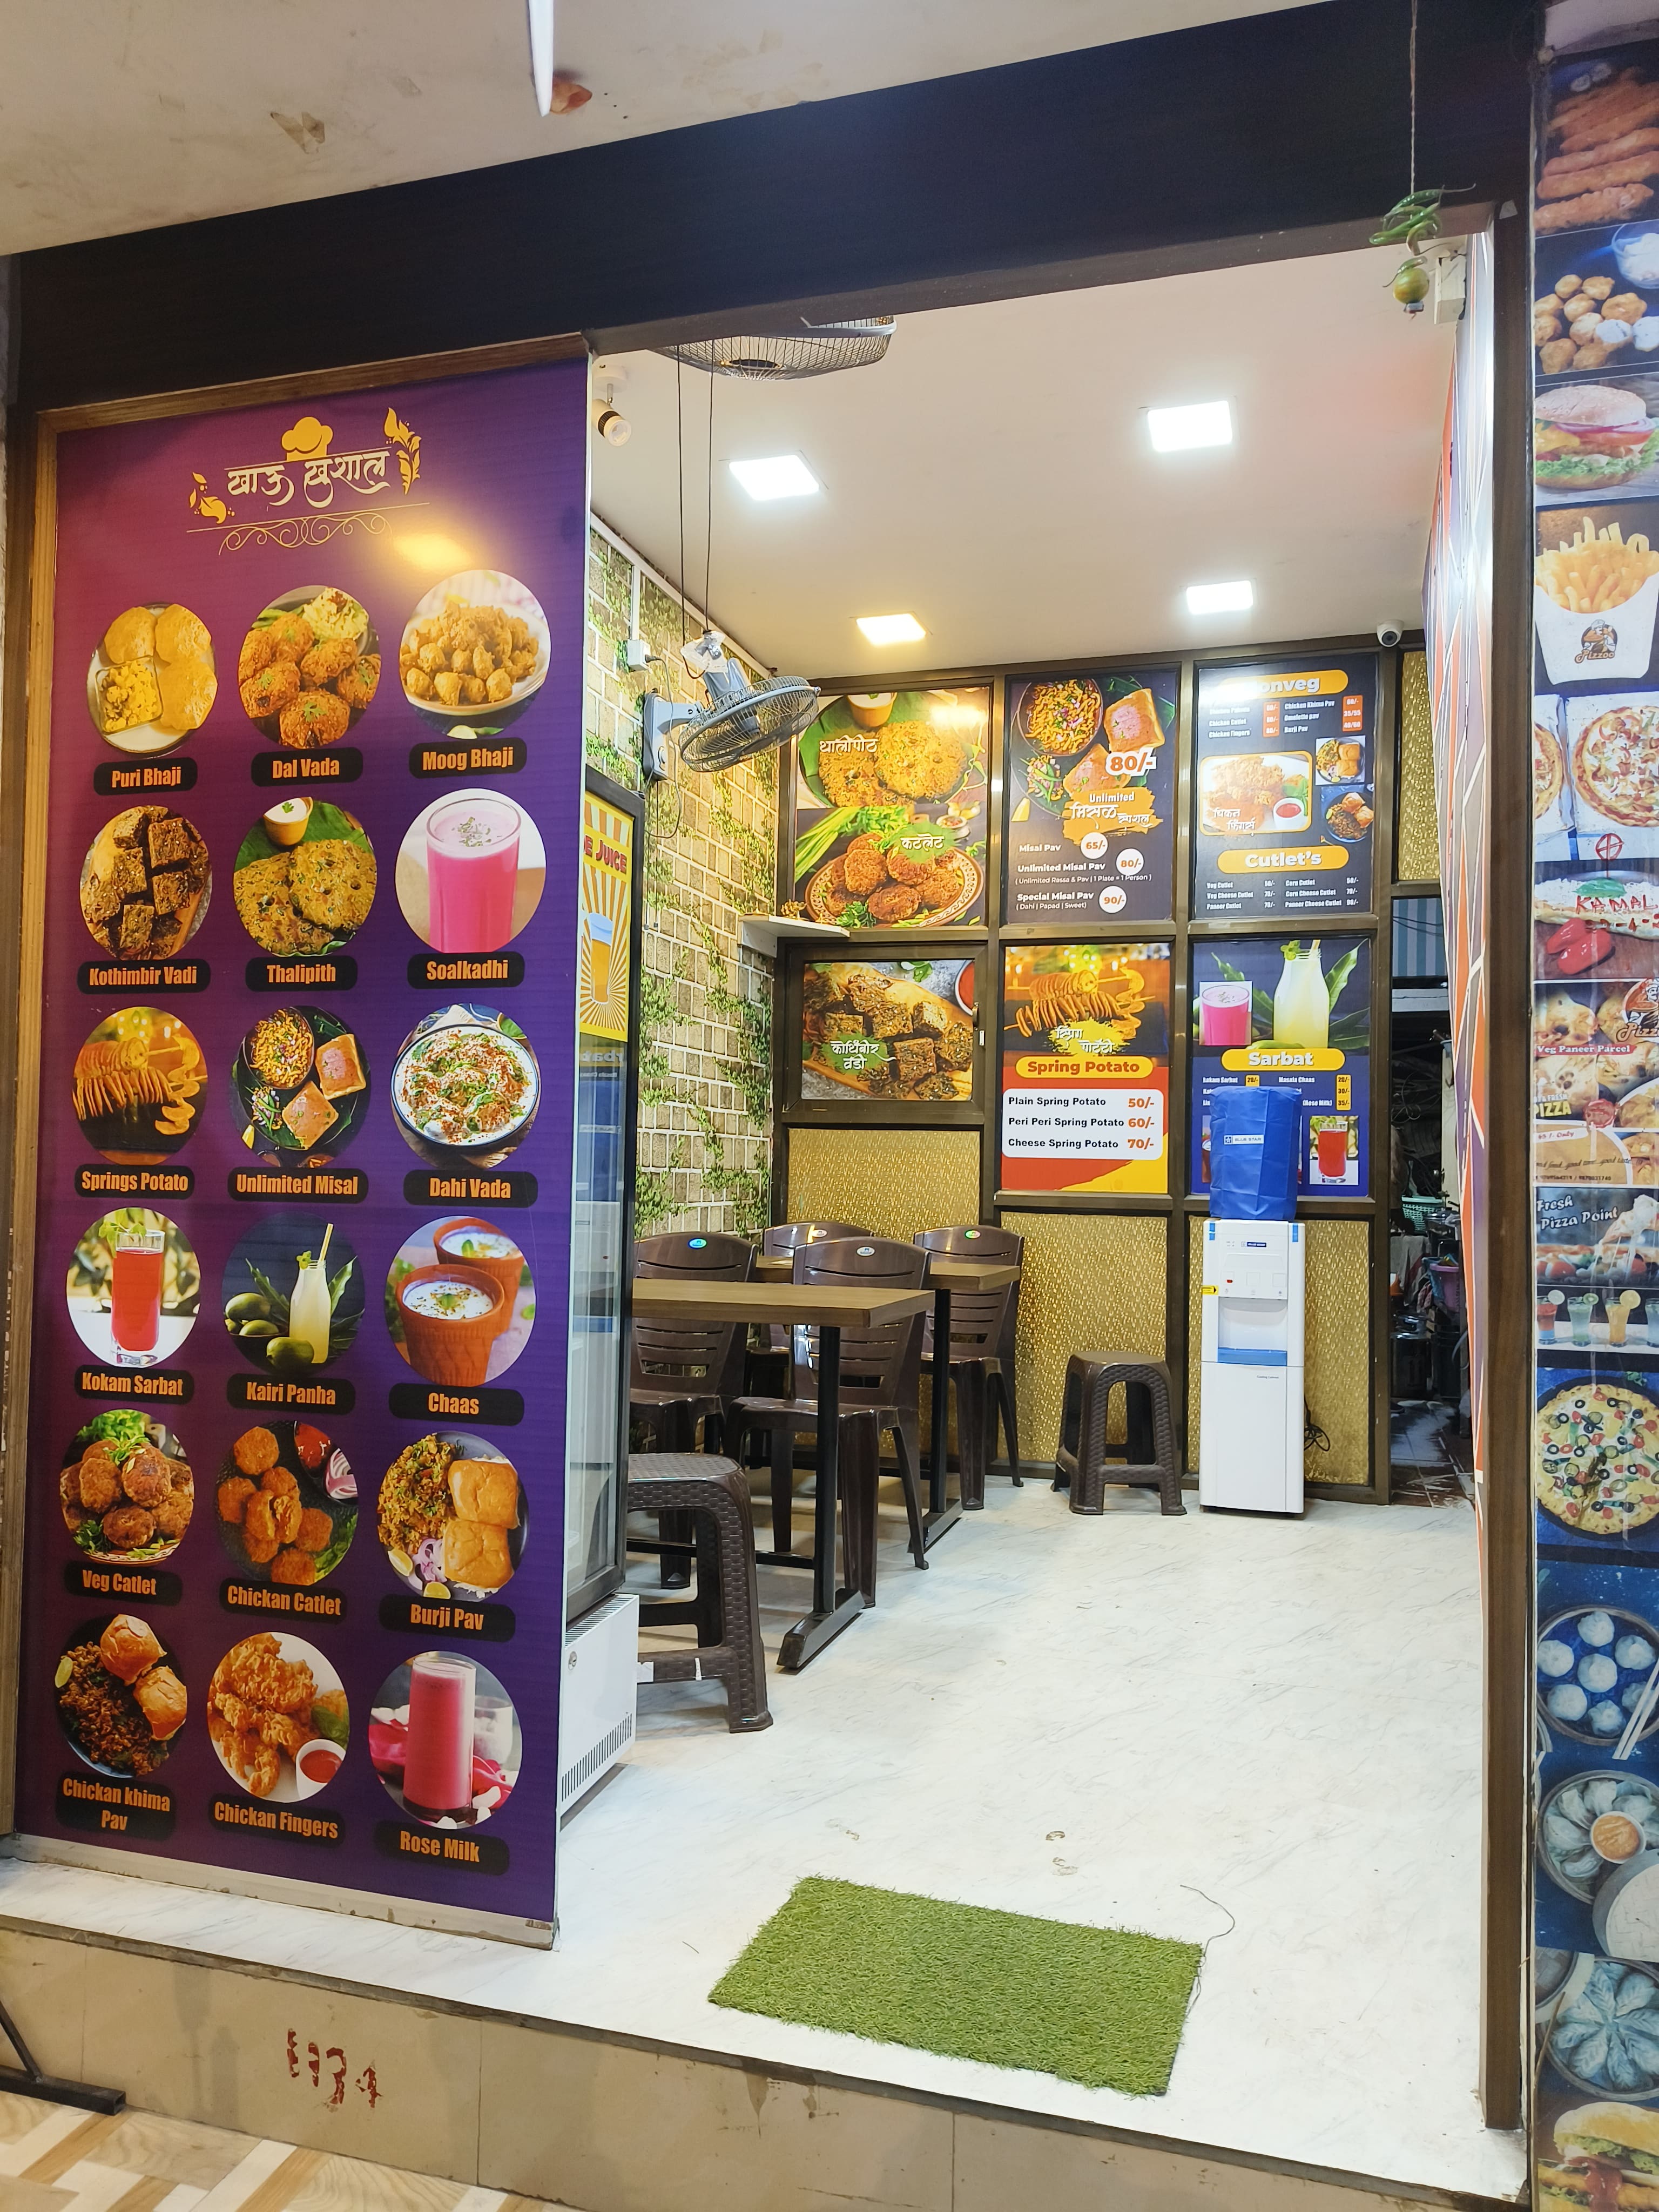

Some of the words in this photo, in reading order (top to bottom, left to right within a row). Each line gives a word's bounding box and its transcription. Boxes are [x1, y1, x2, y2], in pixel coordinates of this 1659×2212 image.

[227, 465, 294, 506] खाऊ
[304, 451, 391, 508] खुशाल
[1575, 649, 1615, 663] Pizzoo
[1256, 678, 1320, 693] onveg
[819, 734, 879, 756] थालीपीठ
[272, 759, 298, 779] Dal
[301, 758, 340, 777] Vada
[422, 750, 467, 772] Moog
[470, 747, 514, 768] Bhaji
[1110, 752, 1152, 772] 80/-
[112, 768, 141, 788] Puri
[143, 767, 181, 787] Bhaji
[1089, 792, 1134, 802] Unlimited
[1069, 801, 1119, 830] मिसळ
[900, 833, 944, 851] कटलेट
[1020, 844, 1042, 852] Misal
[1086, 840, 1105, 850] 65/-
[596, 838, 627, 875] JUICE
[1017, 864, 1061, 872] Unlimited
[1063, 863, 1087, 871] Misal
[1121, 859, 1142, 868] 80/-
[1017, 893, 1049, 902] Special
[1051, 892, 1075, 900] Misal
[1104, 895, 1125, 905] 90/-
[89, 967, 160, 987] Kothimbir
[161, 966, 197, 984] Vadi
[267, 964, 336, 984] Thalipith
[426, 960, 508, 981] Soalkadhi
[1616, 1022, 1659, 1042] Pizz
[1249, 1051, 1313, 1066] Sarbat
[1536, 1046, 1556, 1055] Veg
[843, 1054, 868, 1070] वडी
[1028, 1060, 1080, 1075] Spring
[1085, 1062, 1139, 1073] Potato
[1037, 1097, 1069, 1107] Spring
[1128, 1097, 1154, 1109] 50/-
[1533, 1101, 1572, 1117] PIZZA
[1055, 1118, 1087, 1127] Spring
[1128, 1117, 1155, 1129] 60/-
[1049, 1139, 1081, 1149] Spring
[1128, 1137, 1154, 1150] 70/-
[82, 1171, 138, 1191] Springs
[140, 1171, 188, 1191] Potato
[237, 1174, 312, 1195] Unlimited
[314, 1175, 358, 1195] Misal
[429, 1177, 467, 1198] Dahi
[469, 1178, 511, 1199] Vada
[1536, 1195, 1573, 1211] Fresh
[1541, 1216, 1578, 1230] Pizza
[1581, 1206, 1617, 1223] Point
[82, 1372, 131, 1394] Kokam
[134, 1374, 183, 1396] Sarbat
[246, 1382, 283, 1402] Kairi
[286, 1384, 336, 1405] Panha
[428, 1393, 479, 1415] Chaas
[82, 1570, 110, 1593] Veg
[112, 1573, 157, 1596] Catlet
[227, 1586, 290, 1611] Chickan
[294, 1591, 341, 1616] Catlet
[410, 1604, 451, 1628] Burji
[454, 1608, 484, 1631] Pav
[63, 1777, 122, 1804] Chickan
[125, 1785, 170, 1812] khima
[101, 1810, 127, 1832] Pav
[214, 1802, 276, 1828] Chickan
[280, 1811, 339, 1839] Fingers
[400, 1831, 441, 1856] Rose
[444, 1837, 480, 1863] Milk
